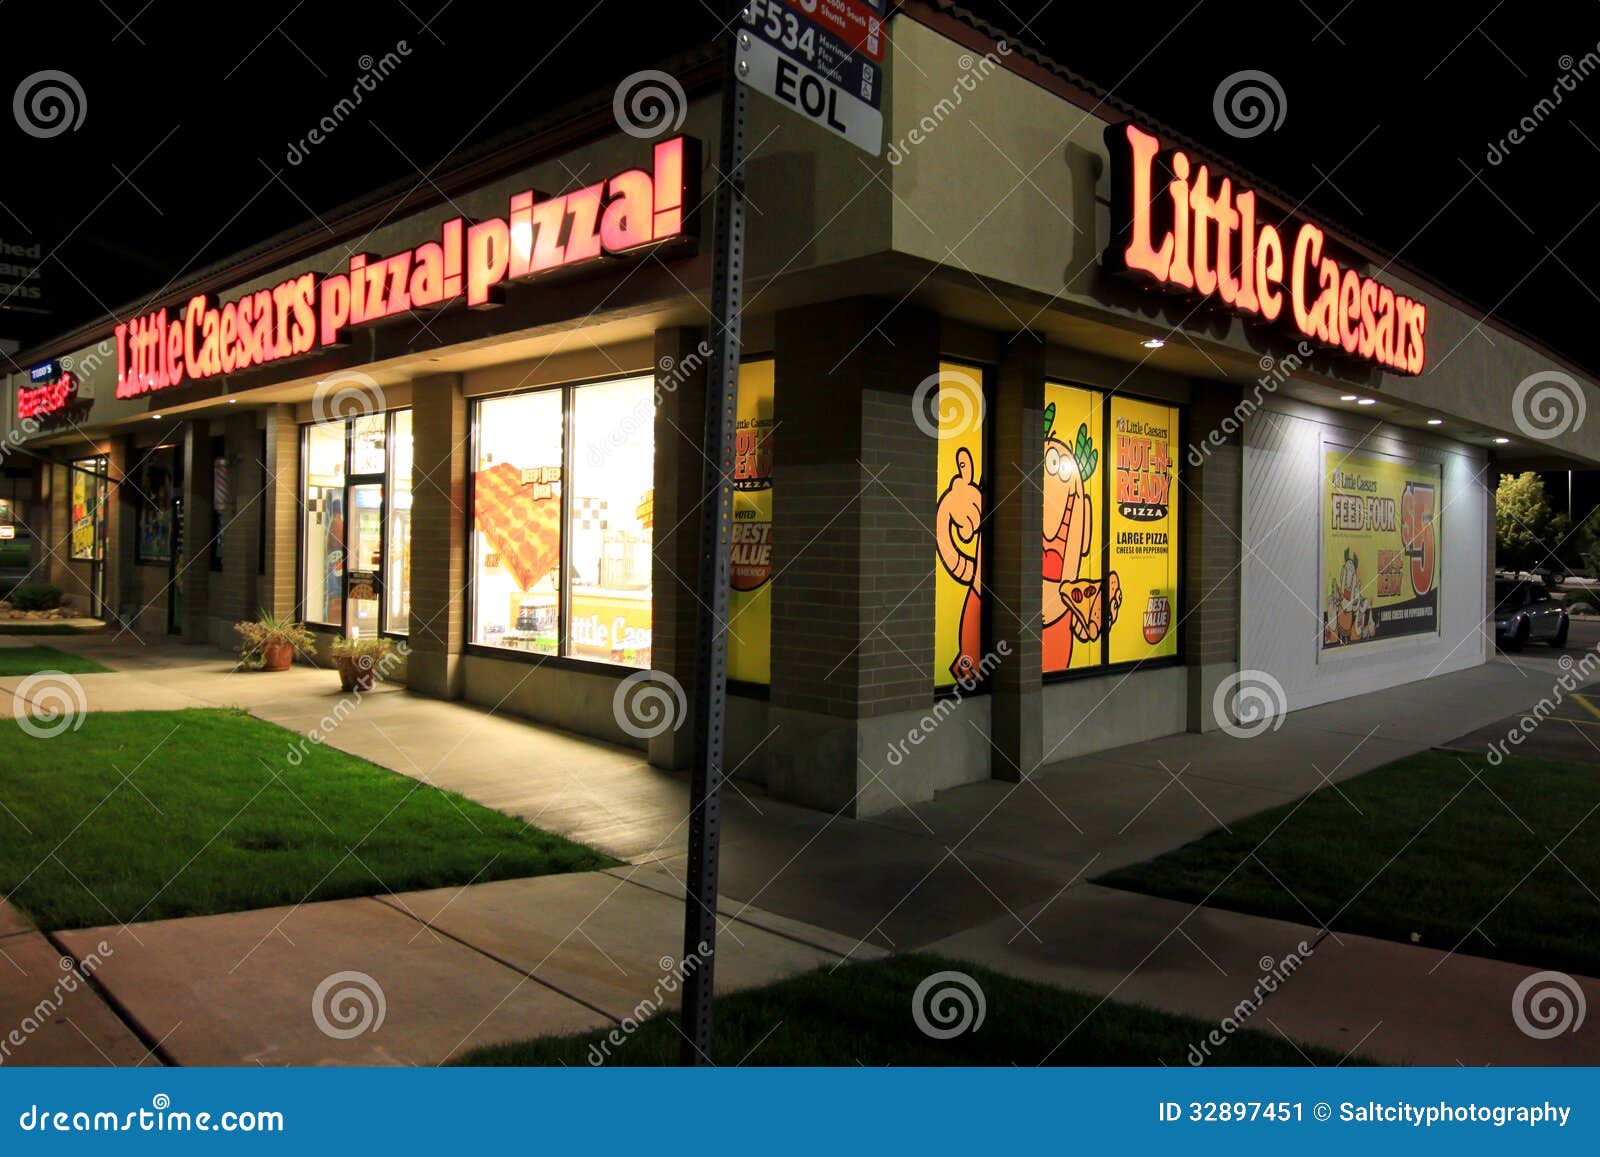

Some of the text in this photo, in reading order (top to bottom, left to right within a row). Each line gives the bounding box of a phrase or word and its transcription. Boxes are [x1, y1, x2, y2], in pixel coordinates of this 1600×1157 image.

[749, 0, 815, 62] F534
[775, 56, 846, 134] EOL
[1125, 124, 1426, 376] Little Caesars
[115, 136, 684, 399] Little Caesars pizza! pizza!
[1126, 420, 1168, 438] Little Caesars
[1117, 470, 1172, 506] READY
[1123, 507, 1163, 517] PIZZA
[732, 523, 771, 543] BEST
[1117, 532, 1168, 545] LARGE PIZZA
[1143, 612, 1168, 627] VALUE
